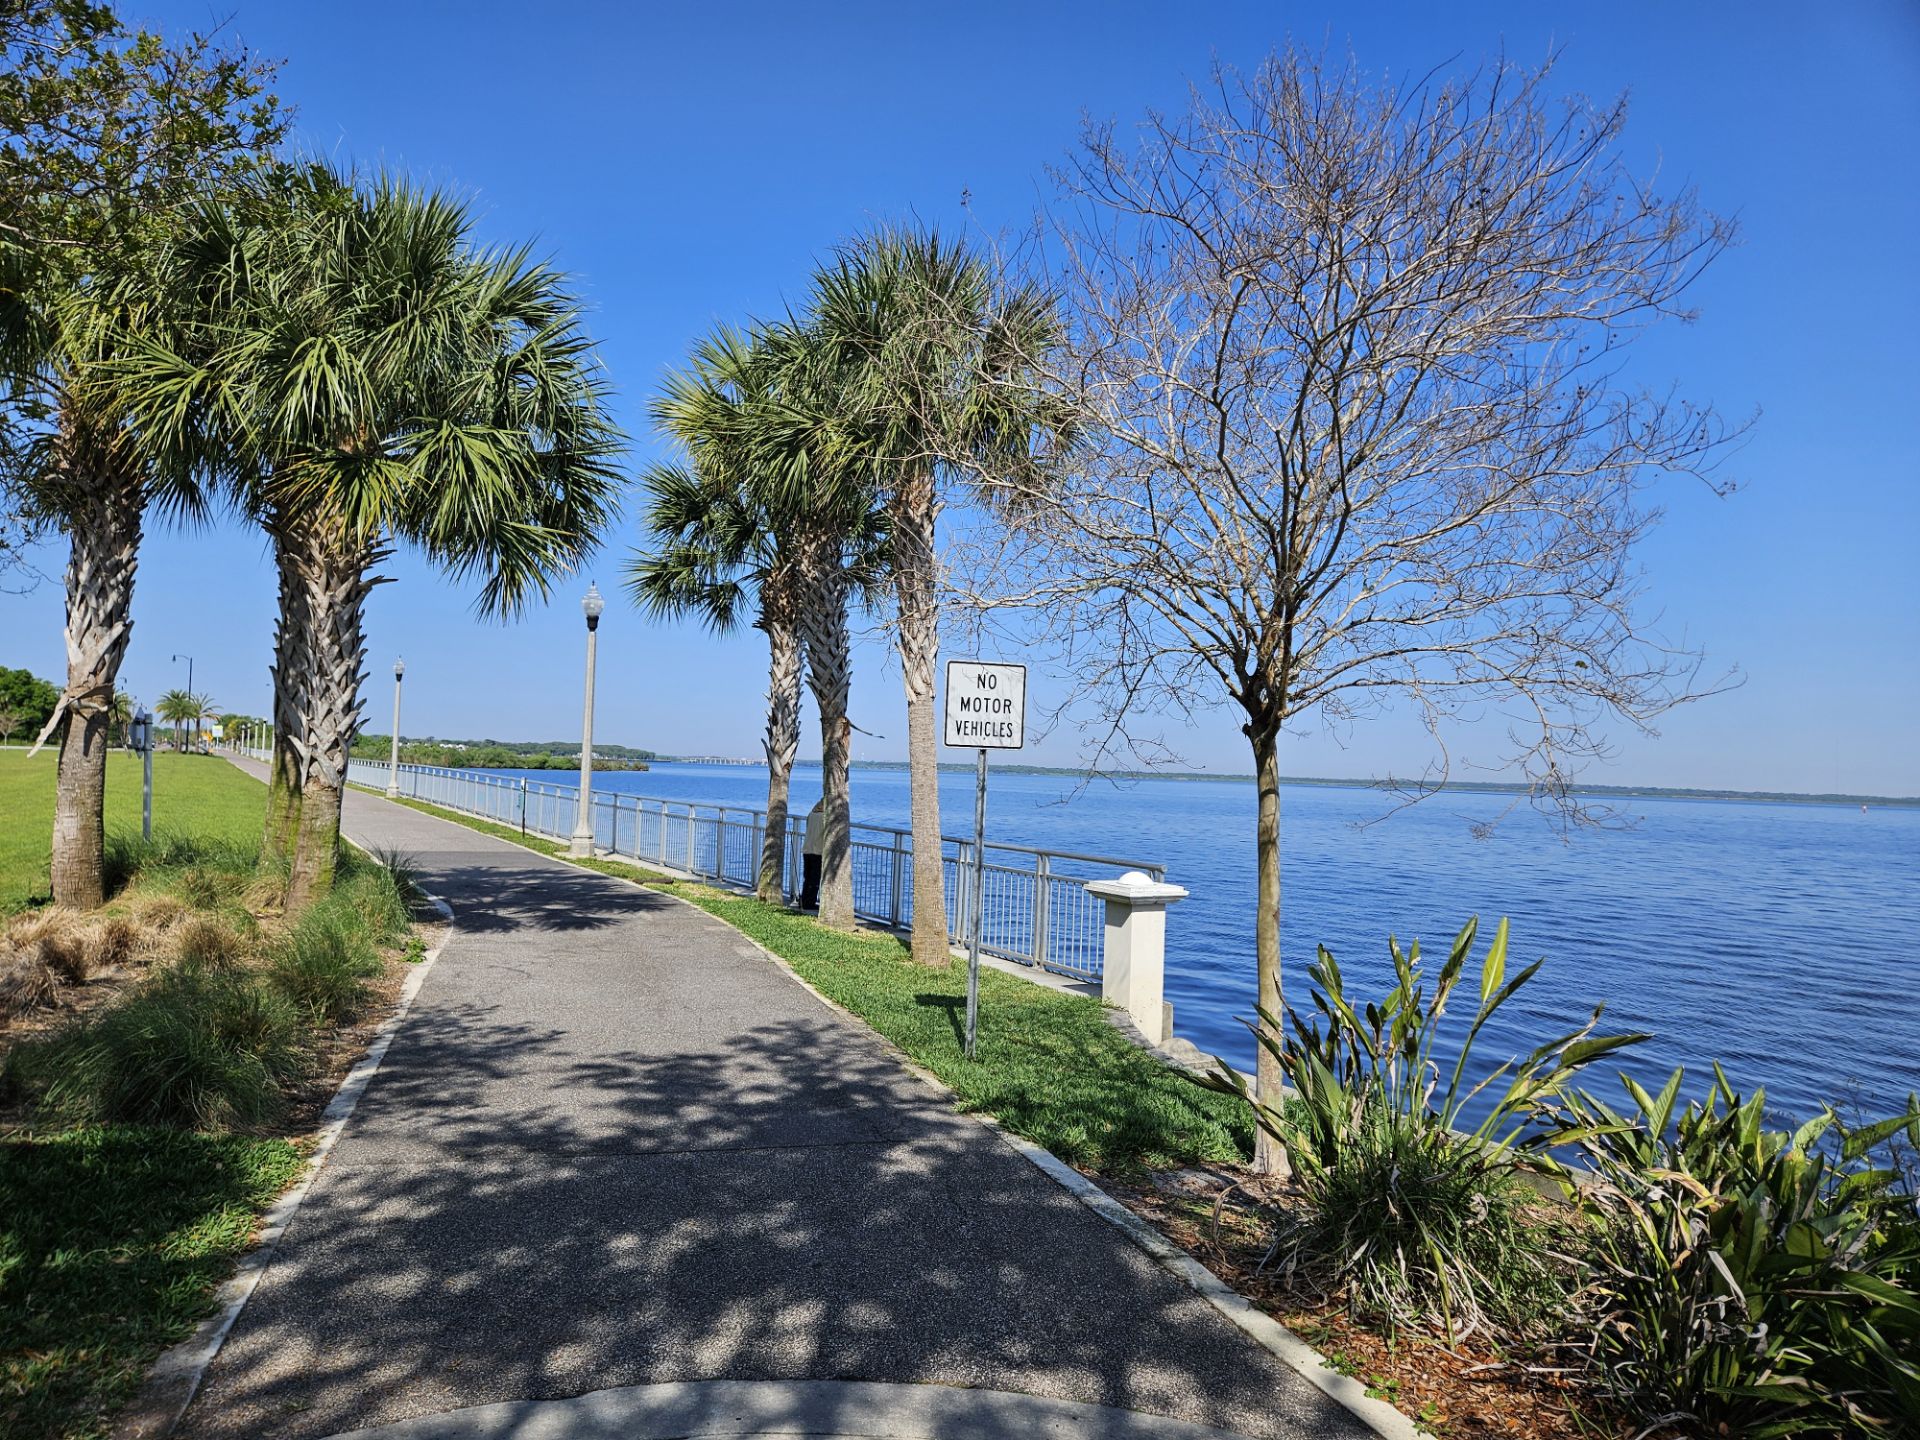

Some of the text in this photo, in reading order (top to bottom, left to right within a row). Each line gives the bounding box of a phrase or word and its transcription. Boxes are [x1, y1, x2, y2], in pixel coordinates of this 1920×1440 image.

[977, 673, 997, 690] NO
[960, 696, 1012, 714] MOTOR
[955, 719, 1013, 738] VEHICLES
